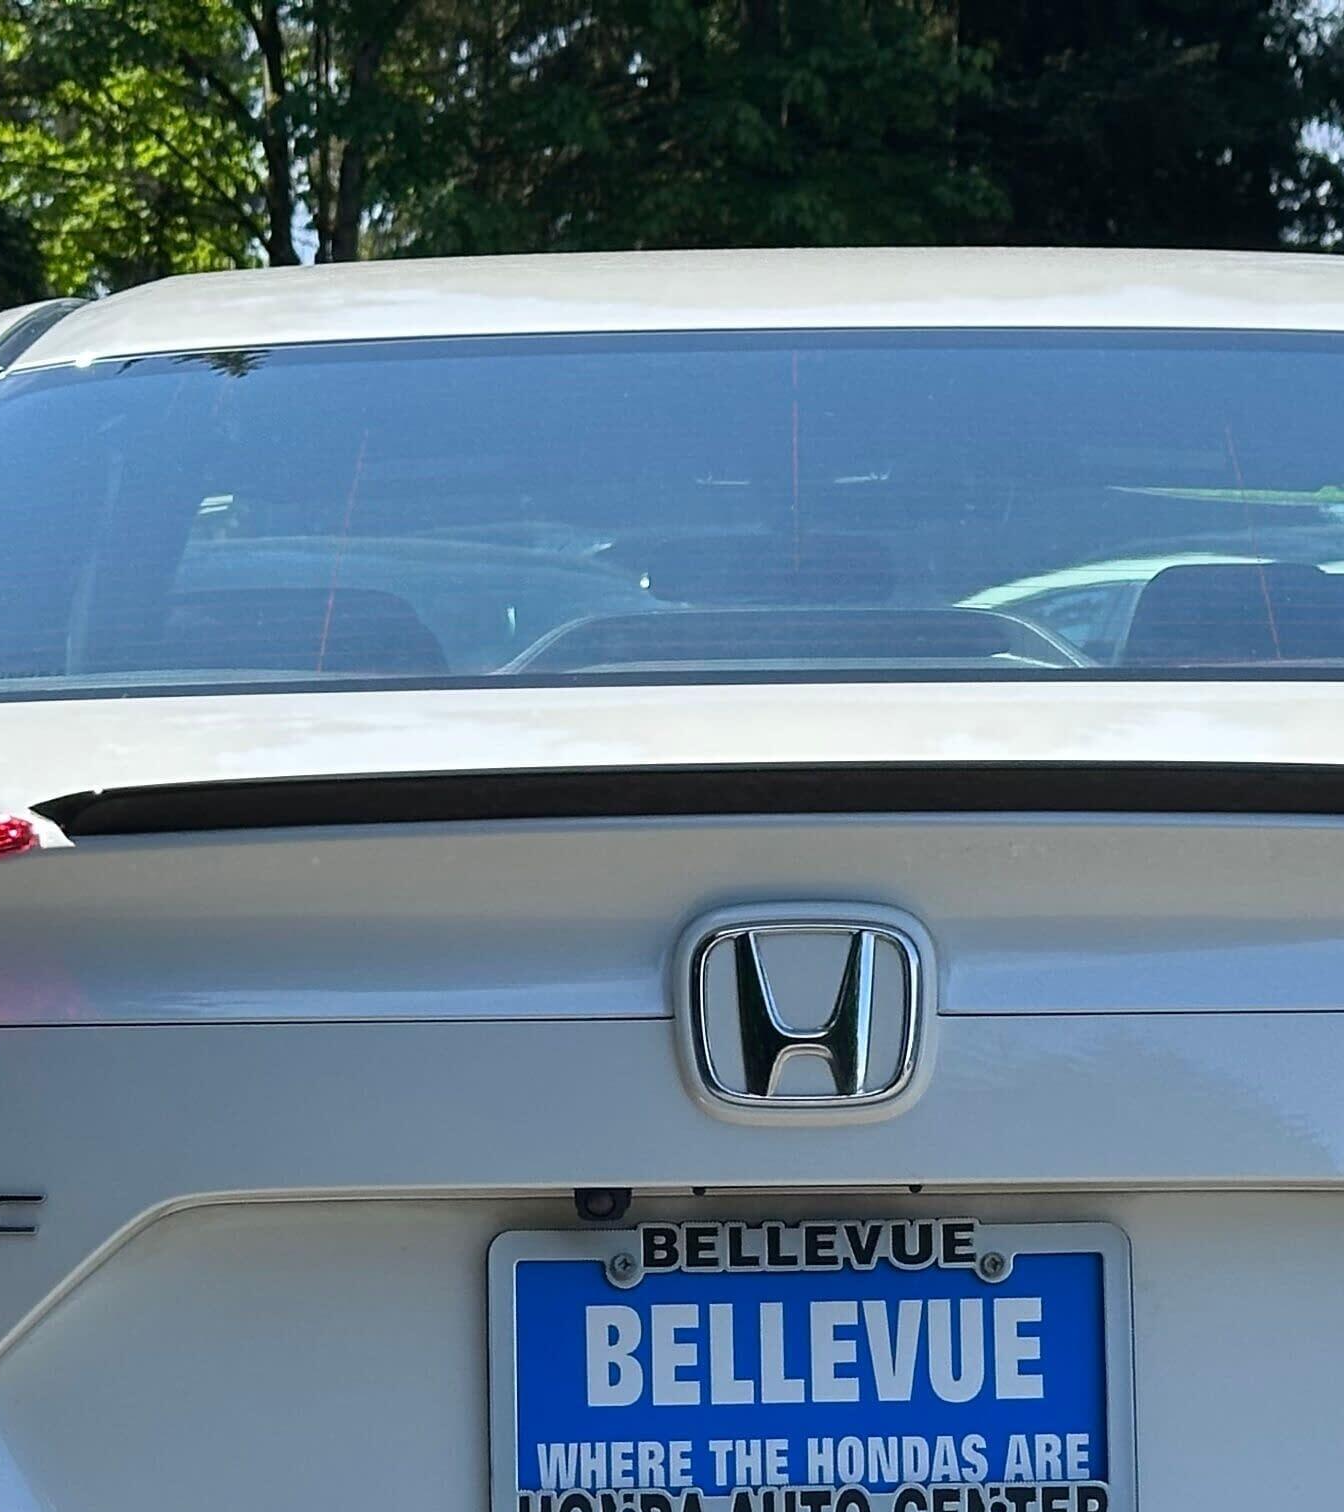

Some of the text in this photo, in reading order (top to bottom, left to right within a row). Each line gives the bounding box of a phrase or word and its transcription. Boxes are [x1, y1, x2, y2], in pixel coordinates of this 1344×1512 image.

[642, 1222, 975, 1270] BELLEVUE
[584, 1297, 1045, 1408] BELLEVUE
[536, 1432, 1091, 1491] WHERE THE HONDAS ARE
